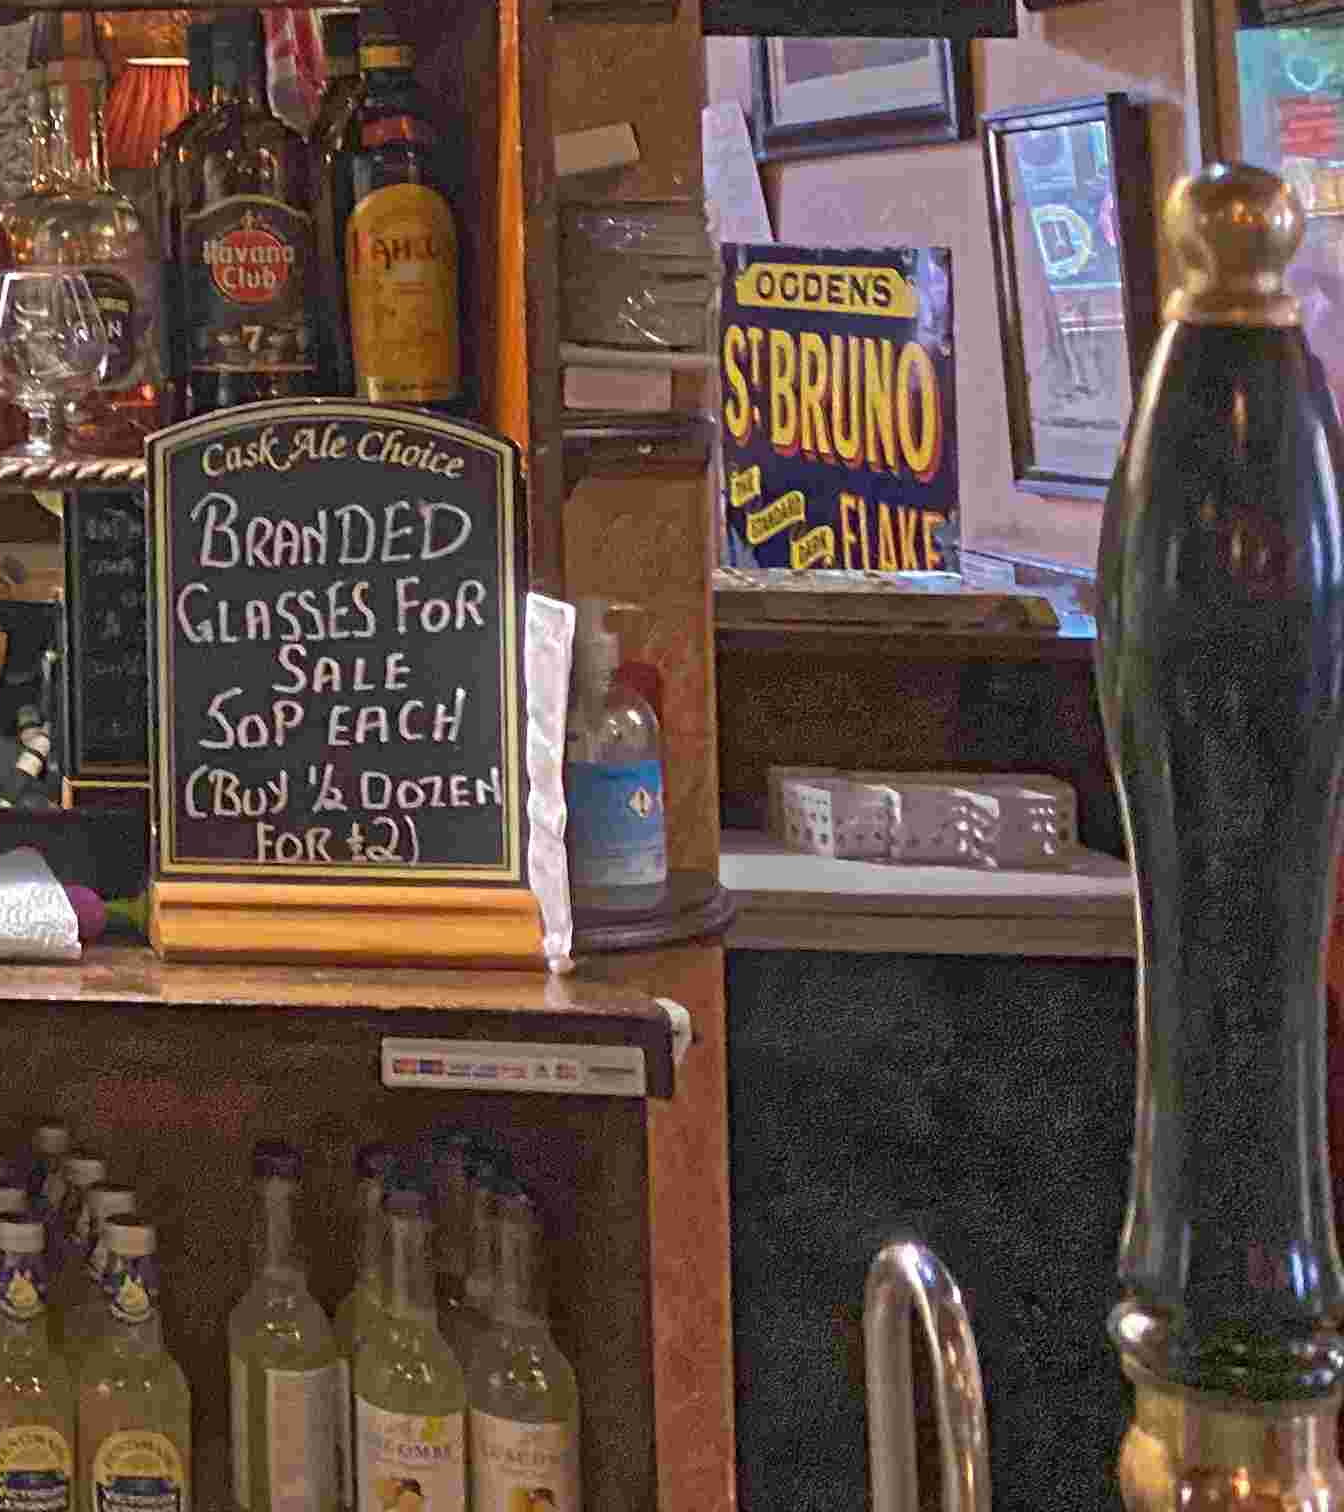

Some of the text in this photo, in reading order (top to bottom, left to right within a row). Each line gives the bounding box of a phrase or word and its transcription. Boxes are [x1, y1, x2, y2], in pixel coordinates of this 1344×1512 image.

[202, 239, 296, 267] Havana
[222, 261, 278, 289] Club
[755, 269, 894, 308] OGDENS
[241, 326, 263, 353] 7
[766, 328, 942, 478] BRUNO
[201, 422, 465, 479] Cask Ale Choice
[189, 491, 474, 569] BRANDED
[839, 491, 945, 570] FLAKE
[175, 575, 488, 644] GLASSES FOR
[272, 642, 412, 695] SALE
[359, 766, 504, 810] DOZEN
[256, 820, 332, 864] FOR
